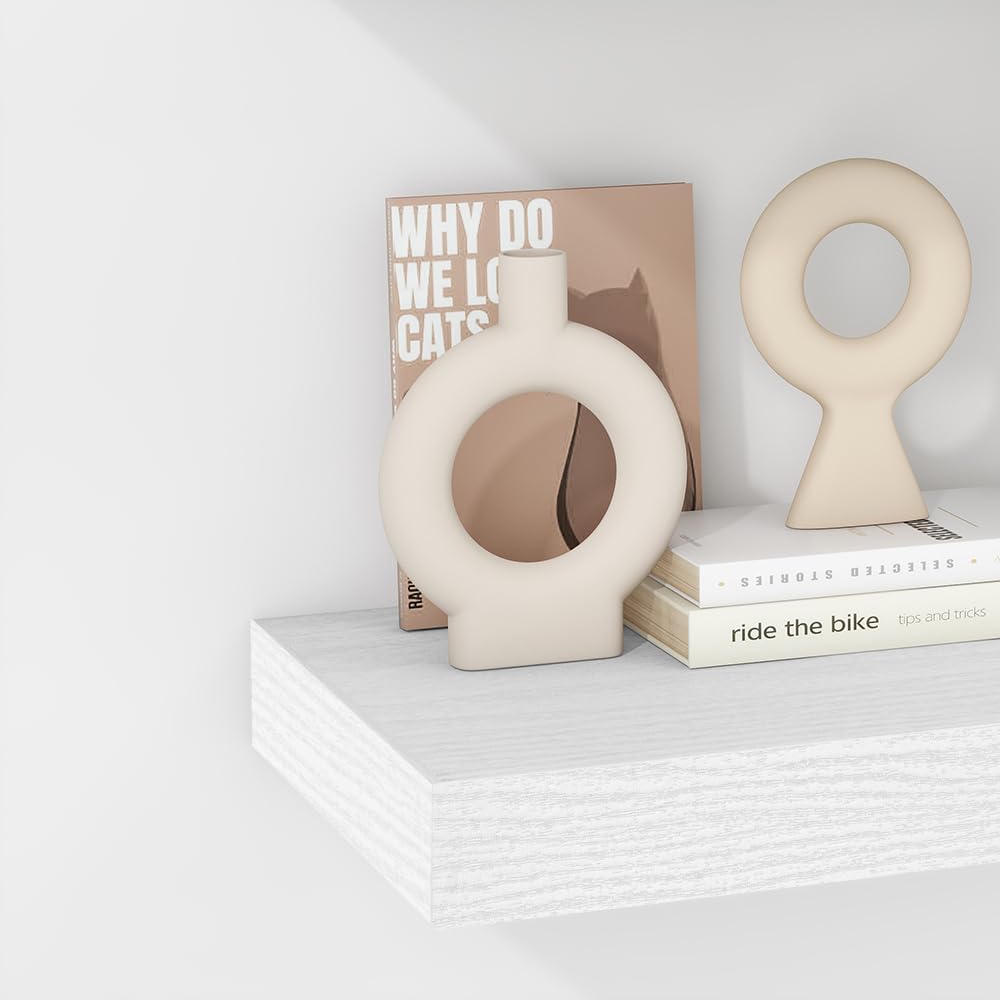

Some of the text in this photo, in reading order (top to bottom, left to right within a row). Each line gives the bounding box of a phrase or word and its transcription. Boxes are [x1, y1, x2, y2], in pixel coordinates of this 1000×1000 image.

[392, 202, 483, 258] WHY
[499, 198, 553, 250] DO
[395, 260, 454, 310] WE
[741, 558, 954, 587] SELECTED STORIES
[732, 614, 879, 642] ride the bike
[898, 607, 986, 626] tips and tricks
